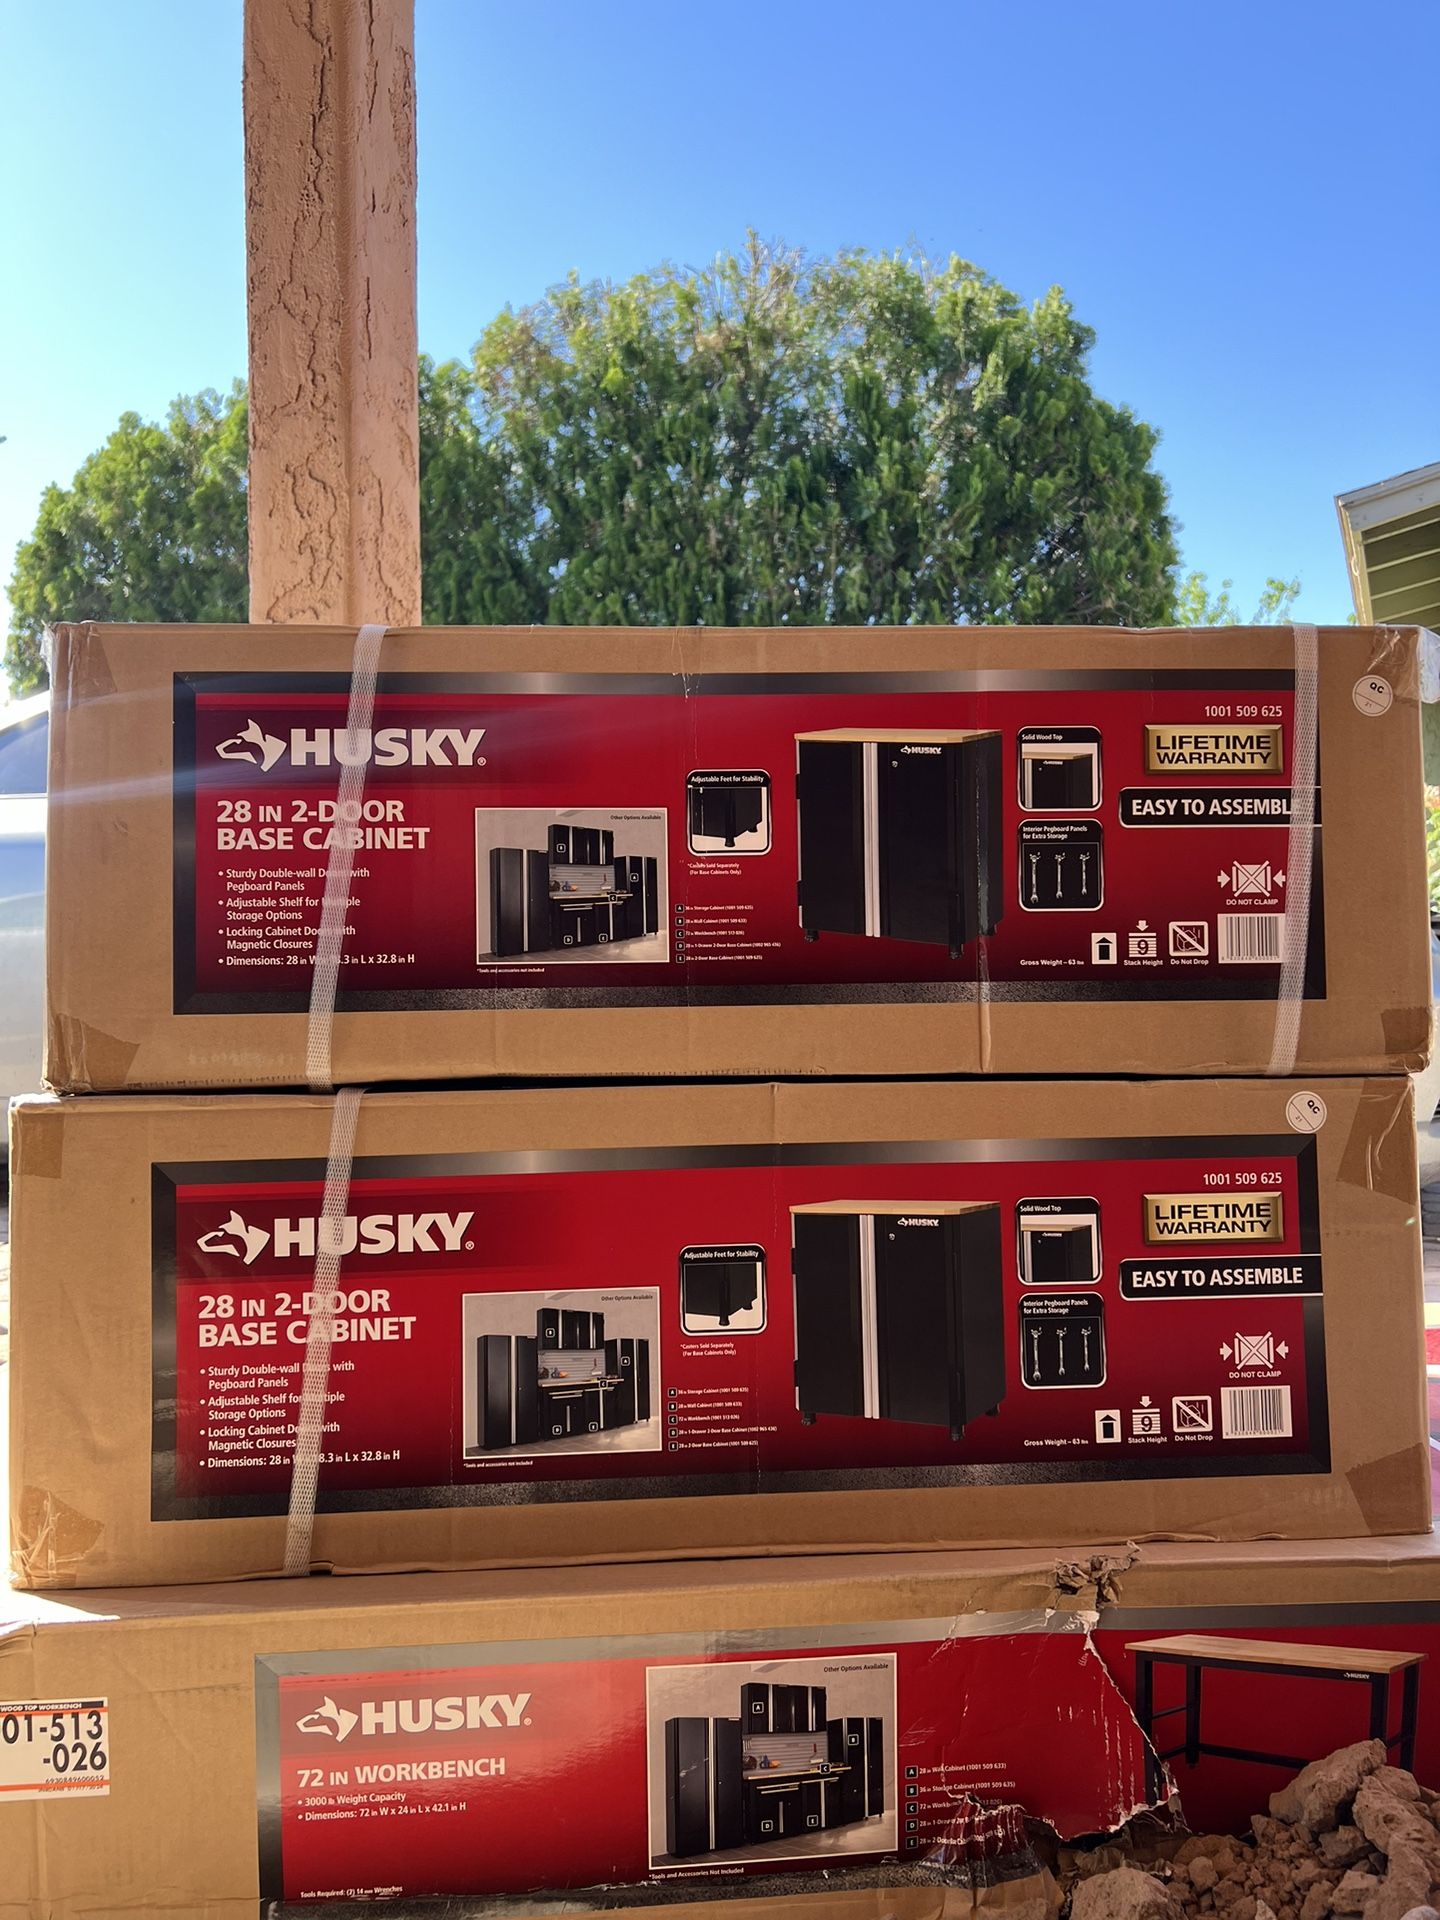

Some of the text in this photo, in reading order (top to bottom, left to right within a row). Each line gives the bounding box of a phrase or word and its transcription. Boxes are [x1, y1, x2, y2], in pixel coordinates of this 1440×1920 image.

[1370, 682, 1384, 693] QC
[1205, 706, 1282, 717] 1001 509 625
[291, 728, 486, 766] HUSKY
[911, 746, 942, 754] HUSKY
[1156, 736, 1271, 750] LIFETIME
[1156, 752, 1272, 764] WARRANTY
[216, 800, 405, 823] 28 IN 2-DOOR
[1132, 800, 1178, 815] EASY
[1182, 800, 1205, 815] TO
[216, 828, 293, 850] BASE
[226, 868, 257, 880] Sturdy
[259, 868, 316, 878] Double-wall
[227, 881, 305, 893] Pegboard Panels
[226, 898, 276, 909] Adjustable
[279, 897, 303, 906] Shelf
[305, 897, 319, 906] for
[226, 911, 302, 922] Storage Options
[226, 926, 301, 938] Locking Cabinet
[227, 940, 313, 951] Magnetic Closures
[1137, 939, 1149, 956] 9
[226, 956, 284, 966] Dimensions:
[286, 955, 298, 965] 28
[361, 955, 366, 963] L
[377, 955, 397, 964] 32.8
[407, 954, 415, 963] H
[1307, 1100, 1320, 1113] QC
[1204, 1172, 1282, 1185] 1001 509 625
[1155, 1203, 1271, 1220] LIFETIME
[909, 1218, 939, 1226] HUSKY
[1156, 1220, 1272, 1234] WARRANTY
[274, 1212, 475, 1257] HUSKY
[684, 1252, 713, 1260] Adjustable
[736, 1250, 759, 1258] Stability
[1132, 1267, 1303, 1288] EASY TO ASSEMBLE
[198, 1295, 234, 1319] 28
[241, 1300, 265, 1318] IN
[1044, 1300, 1070, 1308] Pegboard
[199, 1322, 277, 1348] BASE
[208, 1366, 240, 1378] Sturdy
[242, 1363, 300, 1375] Double-wall
[333, 1361, 354, 1371] with
[209, 1378, 288, 1392] Pegboard Panels
[208, 1395, 260, 1408] Adjustable
[262, 1394, 286, 1404] Shelf
[208, 1409, 286, 1421] Storage Options
[1141, 1415, 1153, 1432] 9
[208, 1426, 245, 1438] Locking
[248, 1425, 285, 1436] Cabinet
[208, 1438, 296, 1452] Magnetic Closures
[1147, 1436, 1167, 1444] Height
[208, 1457, 266, 1468] Dimensions:
[269, 1455, 281, 1465] 28
[283, 1456, 290, 1464] in
[336, 1453, 343, 1462] in
[345, 1452, 350, 1462] L
[360, 1451, 381, 1461] 32.8
[383, 1452, 390, 1461] in
[393, 1450, 400, 1460] H
[362, 1693, 532, 1735] HUSKY
[2, 1710, 102, 1744] 01-513
[43, 1742, 107, 1773] -026
[297, 1757, 505, 1788] 72 IN WORKBENCH
[305, 1792, 406, 1806] 3000 lb Weight Capacity
[305, 1810, 357, 1821] Dimensions:
[380, 1808, 388, 1816] W
[398, 1806, 408, 1815] 24
[418, 1805, 423, 1813] L
[432, 1803, 449, 1812] 42.1
[459, 1802, 466, 1810] H
[317, 1890, 345, 1898] Required:
